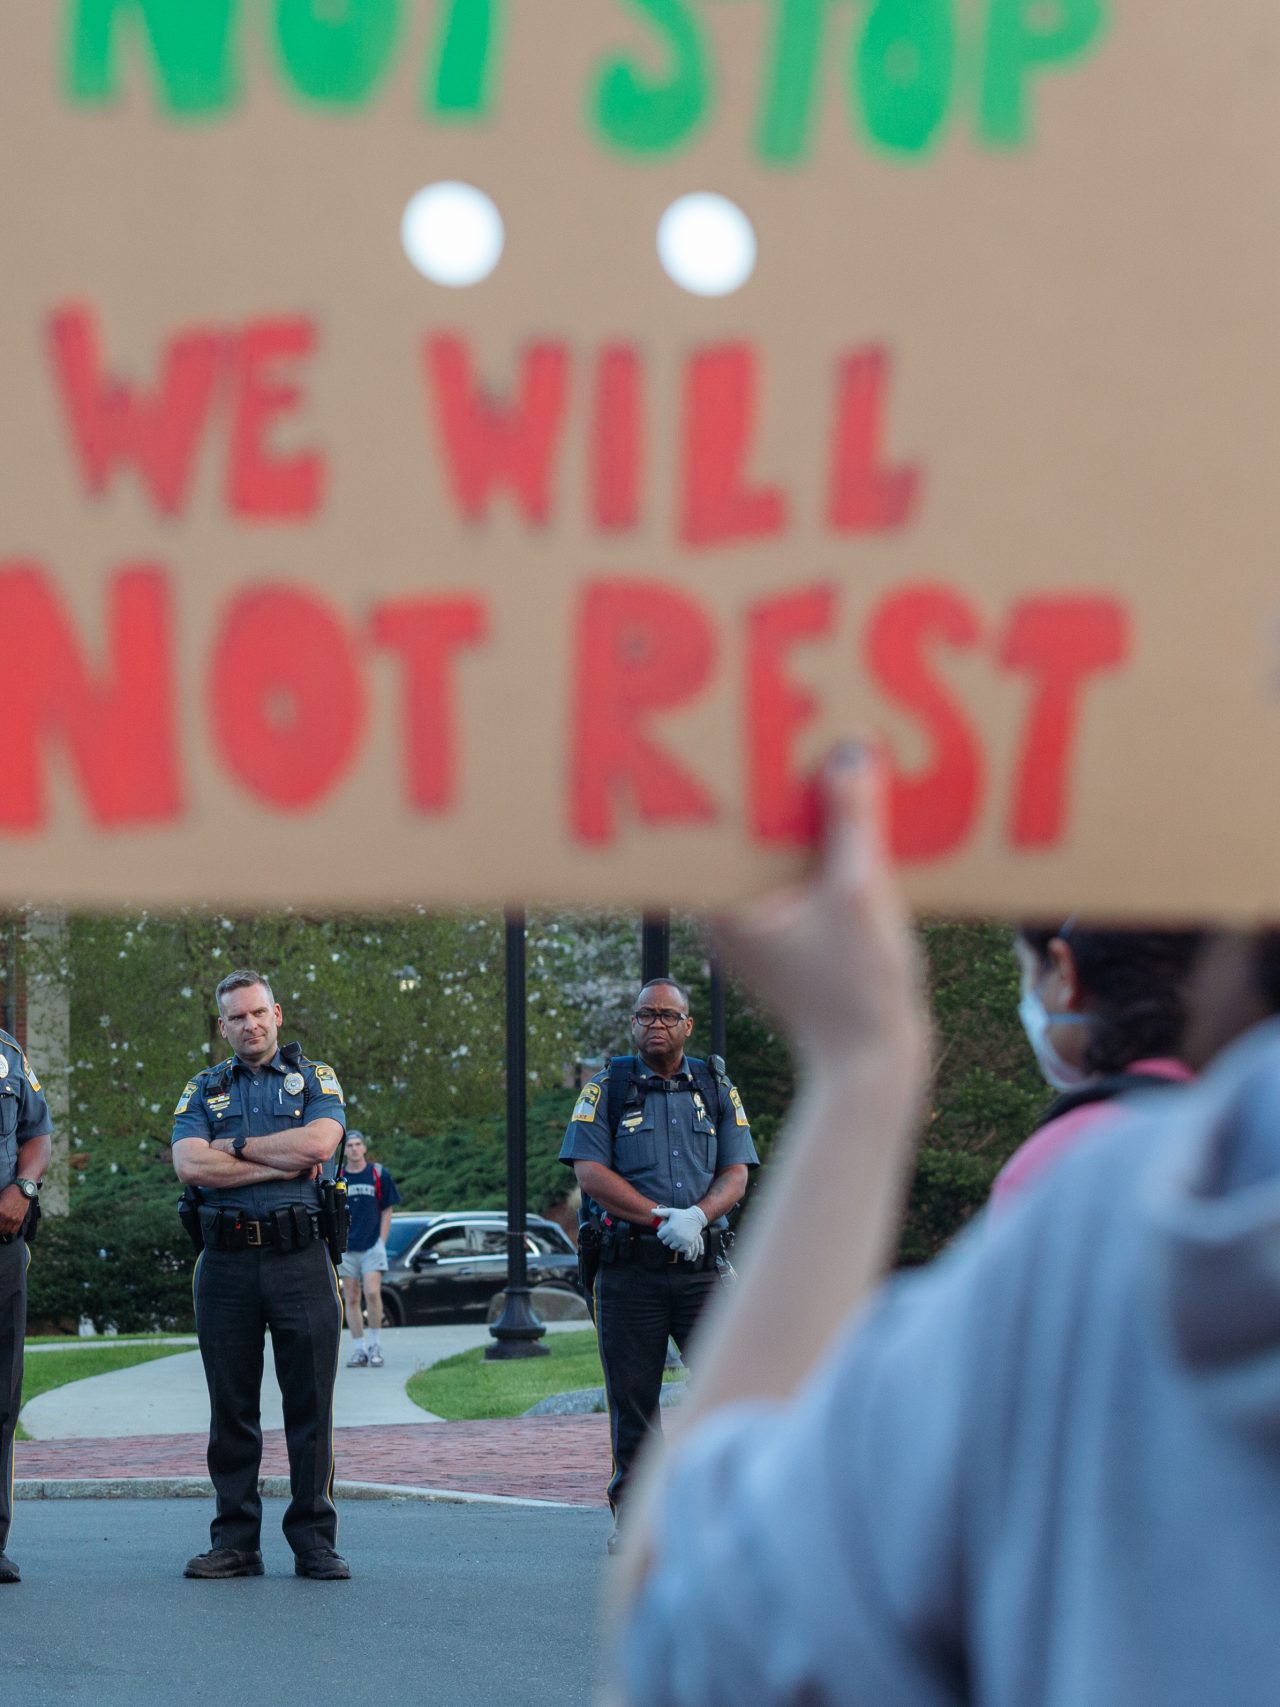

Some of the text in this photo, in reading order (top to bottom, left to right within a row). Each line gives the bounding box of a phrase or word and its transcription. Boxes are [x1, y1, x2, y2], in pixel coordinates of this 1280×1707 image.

[587, 0, 1110, 167] STOP
[45, 299, 923, 554] WE WILL
[562, 573, 1137, 874] REST
